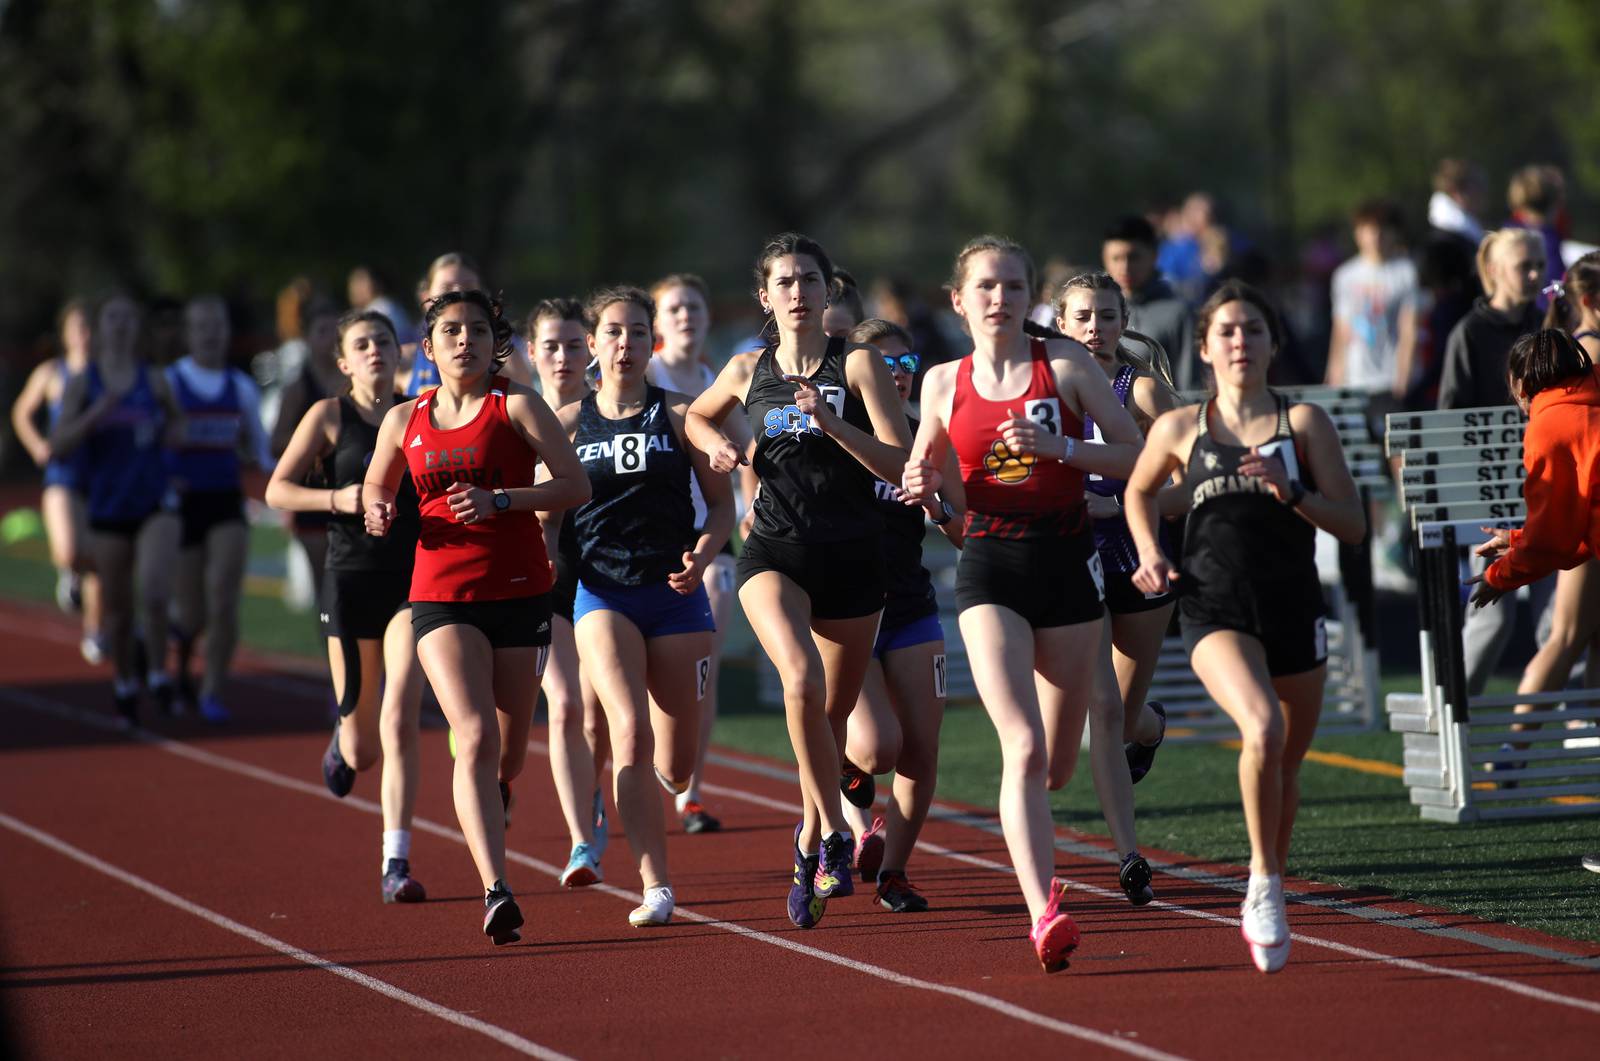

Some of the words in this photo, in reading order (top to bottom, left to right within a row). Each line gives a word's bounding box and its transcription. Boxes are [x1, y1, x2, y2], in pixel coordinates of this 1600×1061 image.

[1032, 402, 1057, 437] 3
[1464, 412, 1493, 427] ST
[1463, 430, 1493, 446] ST
[425, 447, 479, 469] EAST
[621, 436, 640, 471] 8
[1480, 448, 1509, 461] ST
[1477, 464, 1507, 481] ST
[1480, 484, 1509, 500] ST
[1490, 503, 1519, 518] ST
